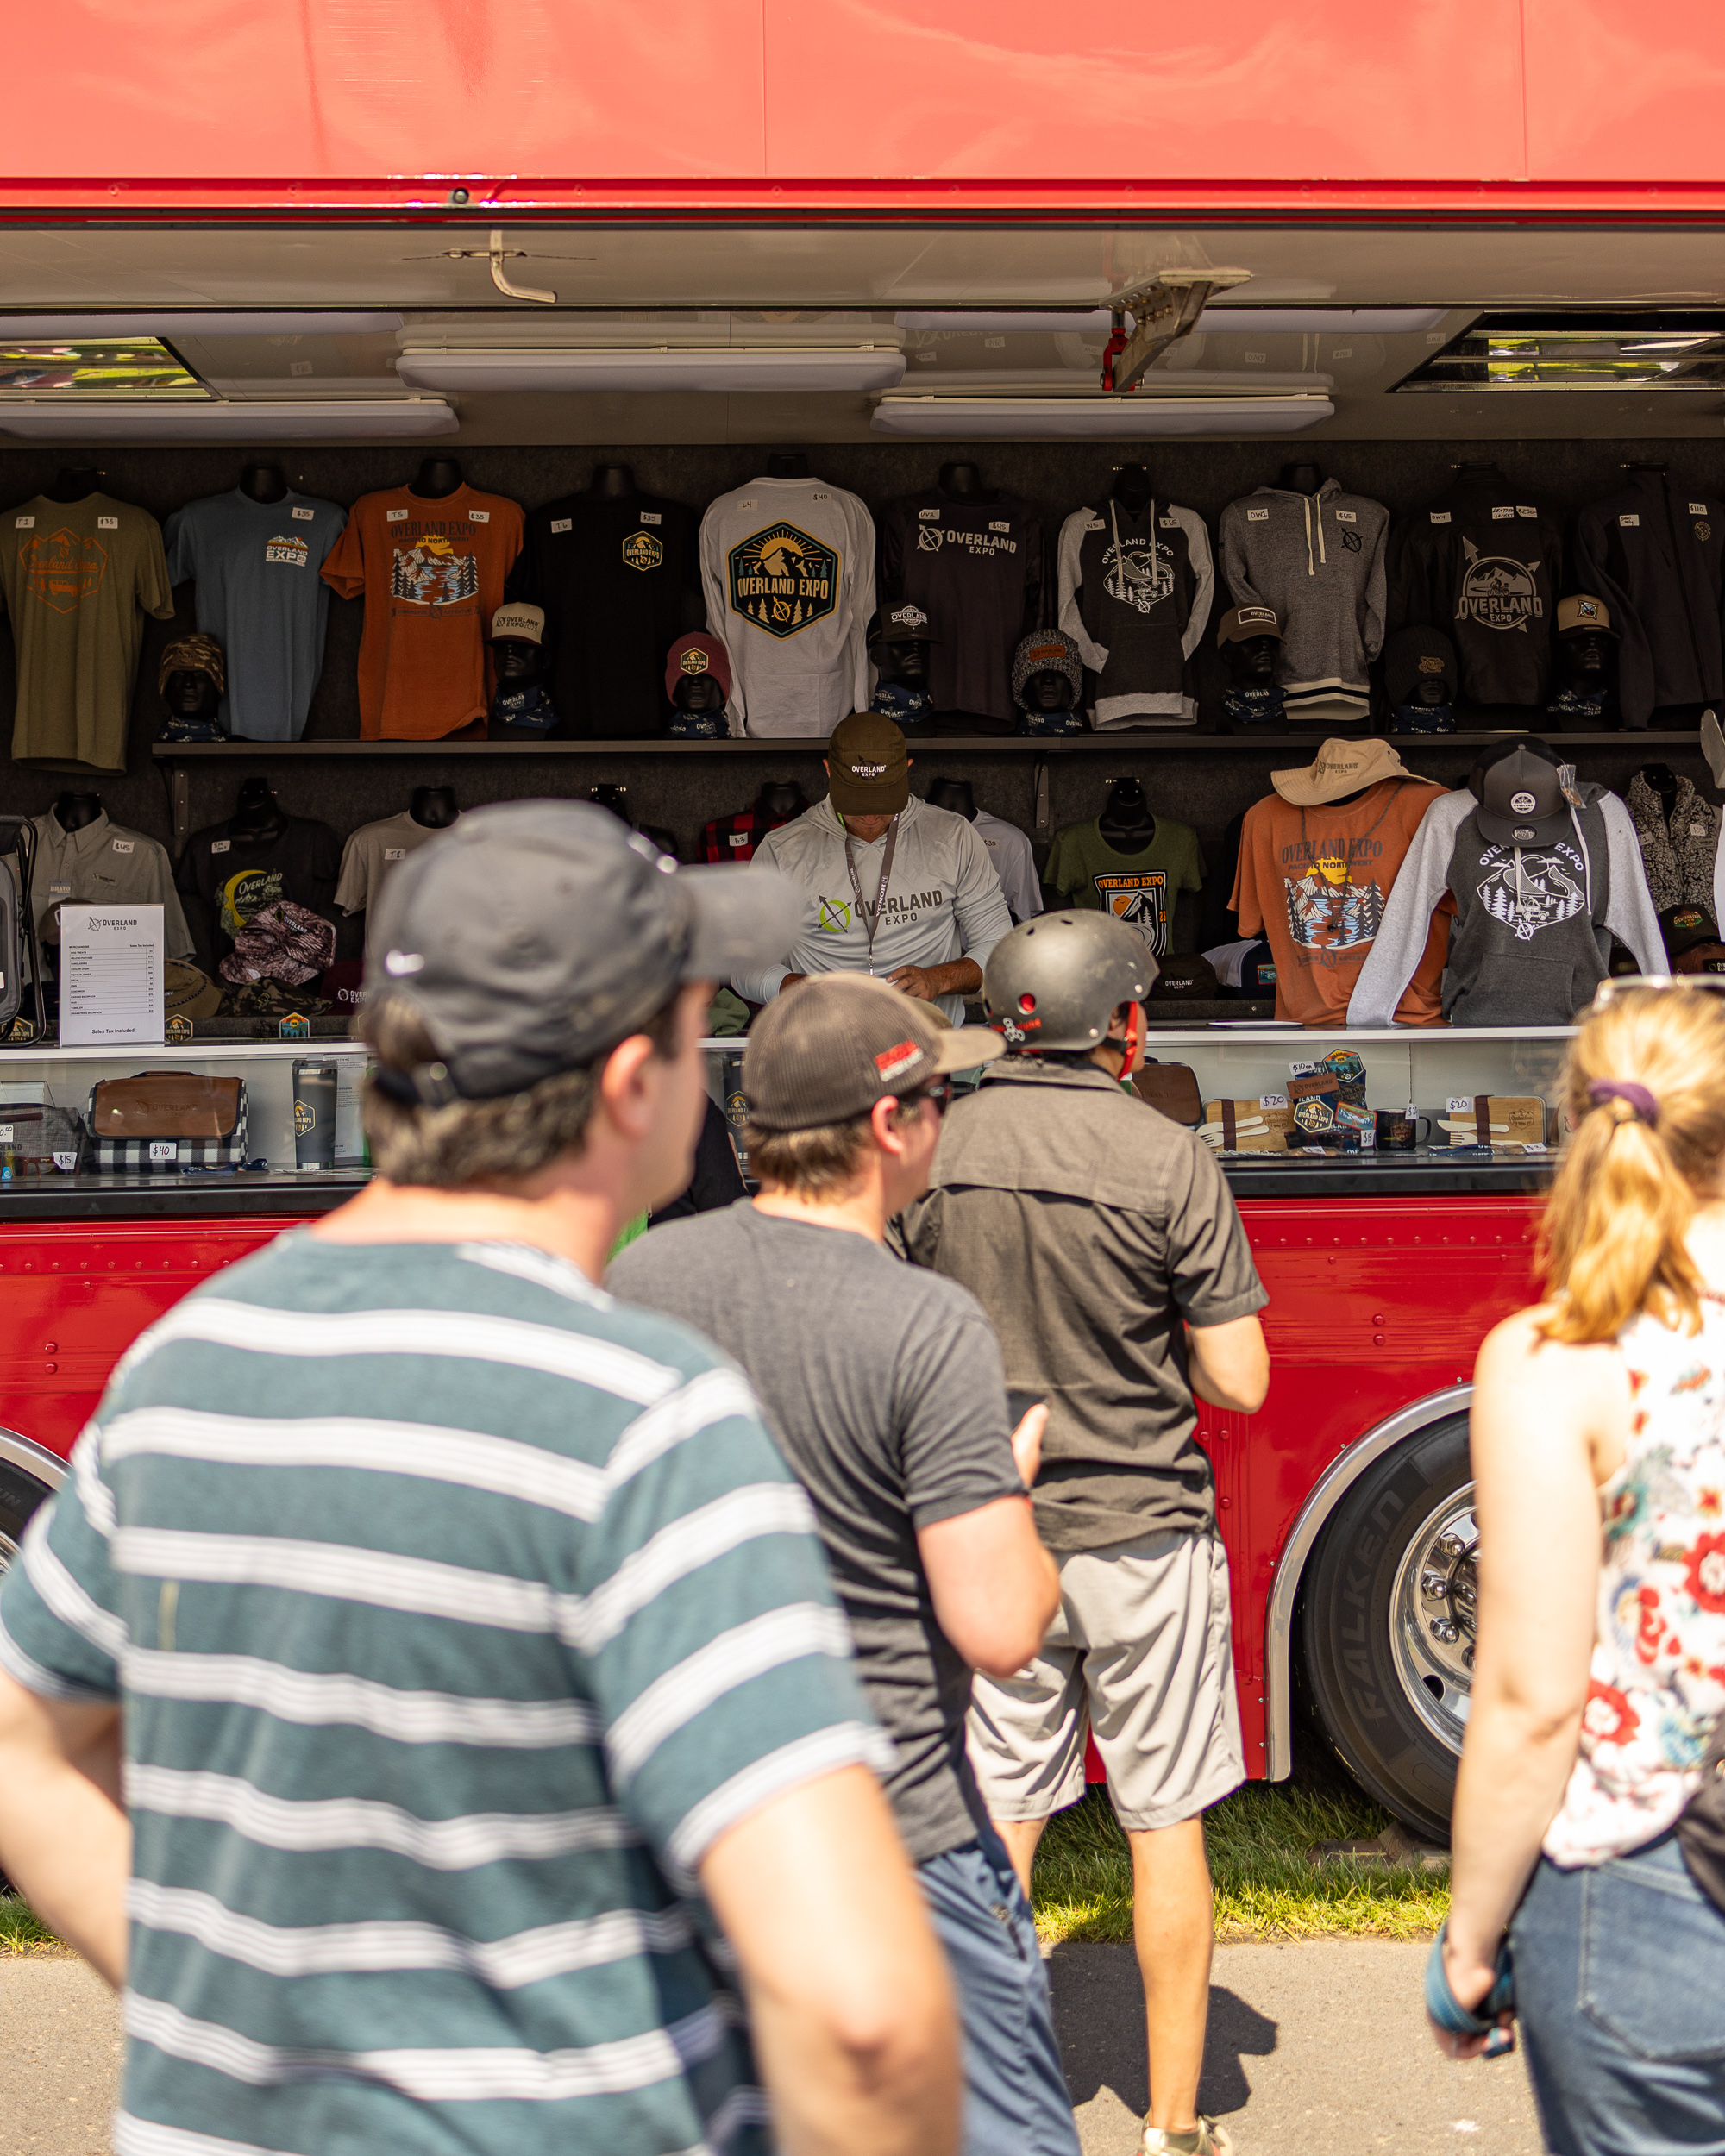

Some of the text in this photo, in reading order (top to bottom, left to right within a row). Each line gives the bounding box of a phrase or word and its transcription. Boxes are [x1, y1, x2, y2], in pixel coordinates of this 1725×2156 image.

[391, 520, 476, 538] OVERLAND EXPO
[947, 530, 1017, 554] OVERLAND
[1149, 541, 1174, 556] XPO
[266, 550, 307, 563] EXPO
[267, 545, 308, 556] OVERLAND
[626, 548, 660, 559] OVERLAND EXPO
[969, 546, 995, 555] EXPO
[737, 577, 829, 599] OVERLAND EXPO
[1458, 596, 1543, 619] OVERLAND
[506, 617, 538, 626] OVERLAND
[891, 613, 927, 623] OVERLAND
[115, 843, 130, 851] $45
[1282, 837, 1383, 863] OVERLAND EXPO
[1479, 842, 1584, 871] OVER EXPO
[239, 873, 283, 894] OVERLAND
[1098, 875, 1164, 888] OVERLAND EXPO
[876, 884, 886, 917] HONDA
[284, 916, 308, 933] OVERLAND
[885, 912, 918, 925] EXPO
[1293, 1063, 1306, 1072] $10
[1304, 1079, 1333, 1088] OVERLAND
[1334, 1087, 1364, 1099] OVERLAND
[1263, 1096, 1284, 1106] $20
[1450, 1100, 1467, 1109] $20
[1298, 1111, 1328, 1124] OVERLAND EXPO
[1364, 1132, 1372, 1143] $15
[153, 1144, 170, 1156] $40
[59, 1155, 72, 1165] $15
[1343, 1487, 1405, 1722] FALKEN
